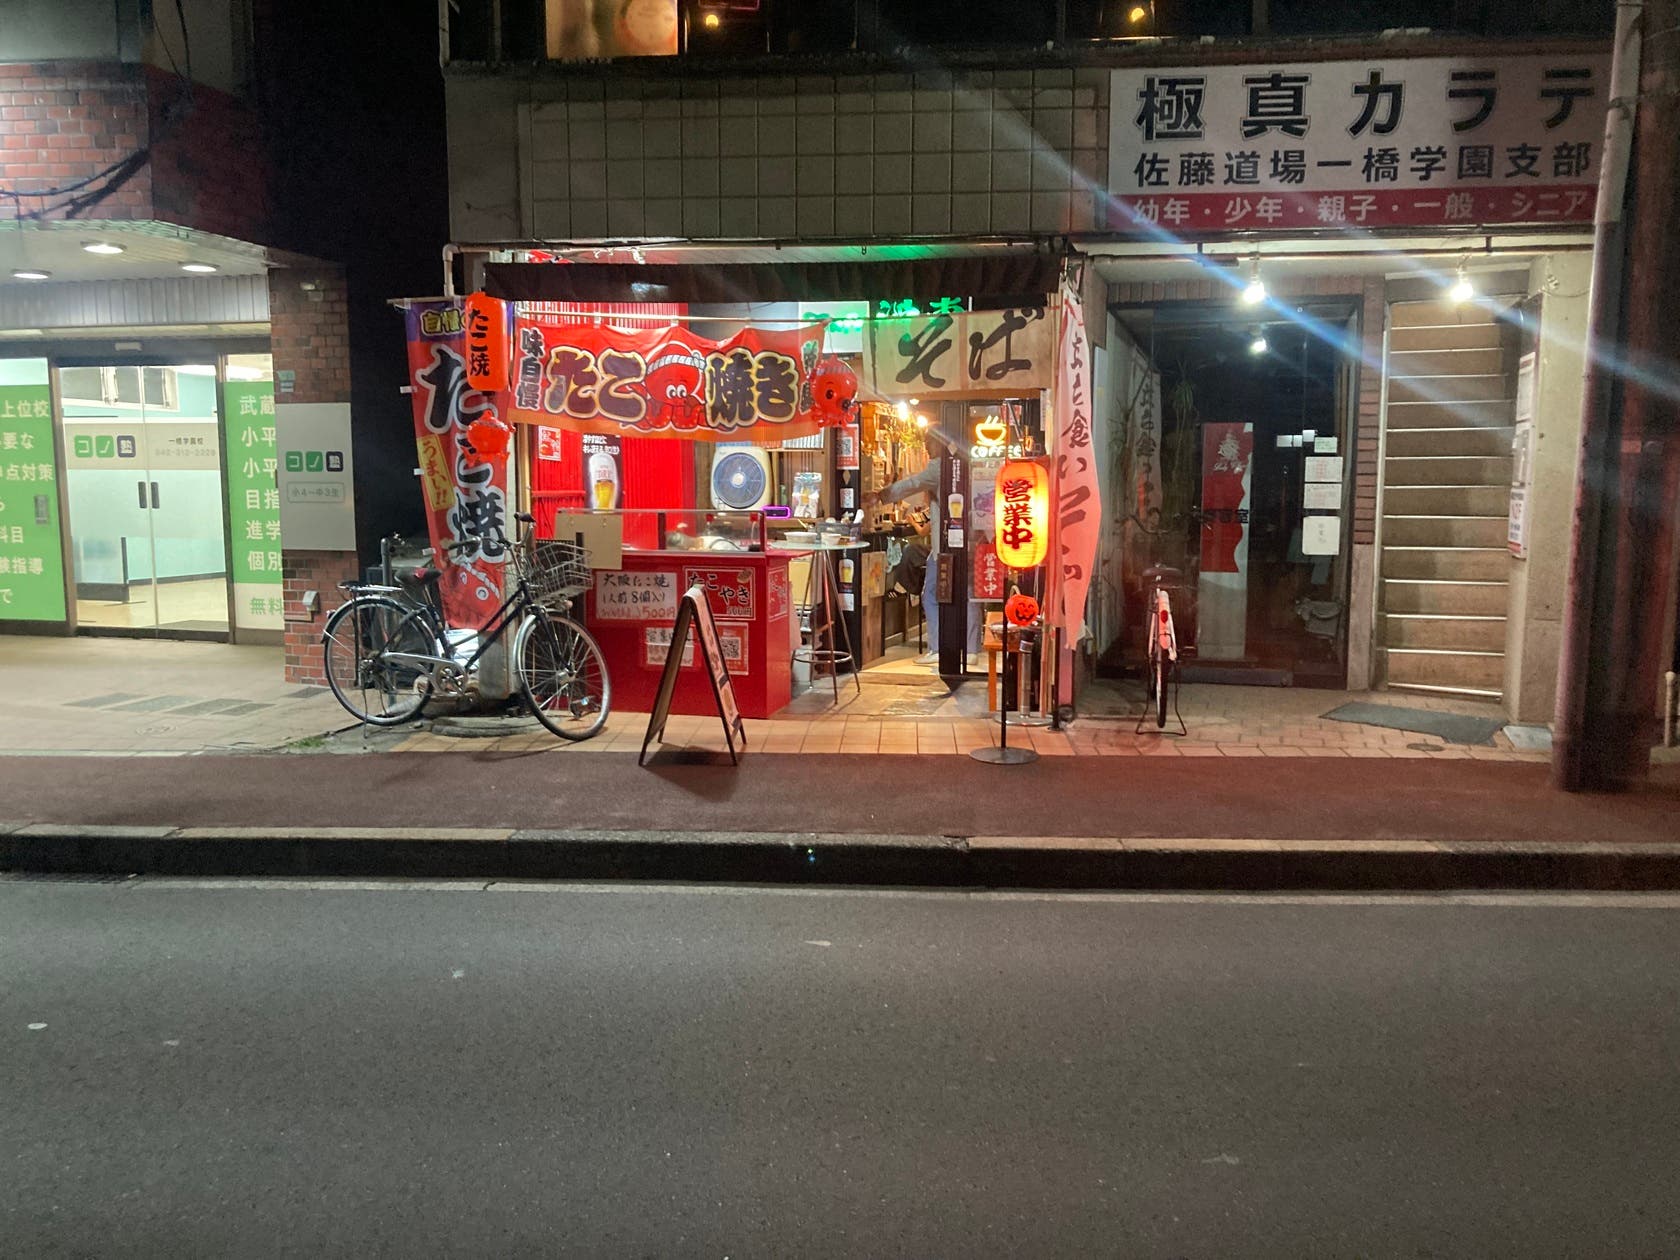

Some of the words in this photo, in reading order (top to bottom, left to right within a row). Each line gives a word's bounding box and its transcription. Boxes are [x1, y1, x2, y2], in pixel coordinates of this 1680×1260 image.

[1134, 67, 1596, 142] 極真カラテ
[1133, 142, 1594, 188] 佐藤道場一橋学園支部
[468, 309, 491, 377] たこ焼
[896, 308, 1045, 388] そば
[516, 328, 546, 410] 味自慢
[0, 432, 34, 449] 要な
[76, 437, 135, 456] コノ塾
[241, 427, 276, 447] 小平
[243, 458, 278, 478] 小平
[287, 453, 342, 470] コノ塾
[0, 464, 54, 482] 点対策
[246, 489, 280, 510] 目指
[1002, 480, 1034, 550] 営業中
[246, 520, 281, 541] 進学
[248, 551, 283, 571] 個別
[983, 553, 998, 596] 営業中
